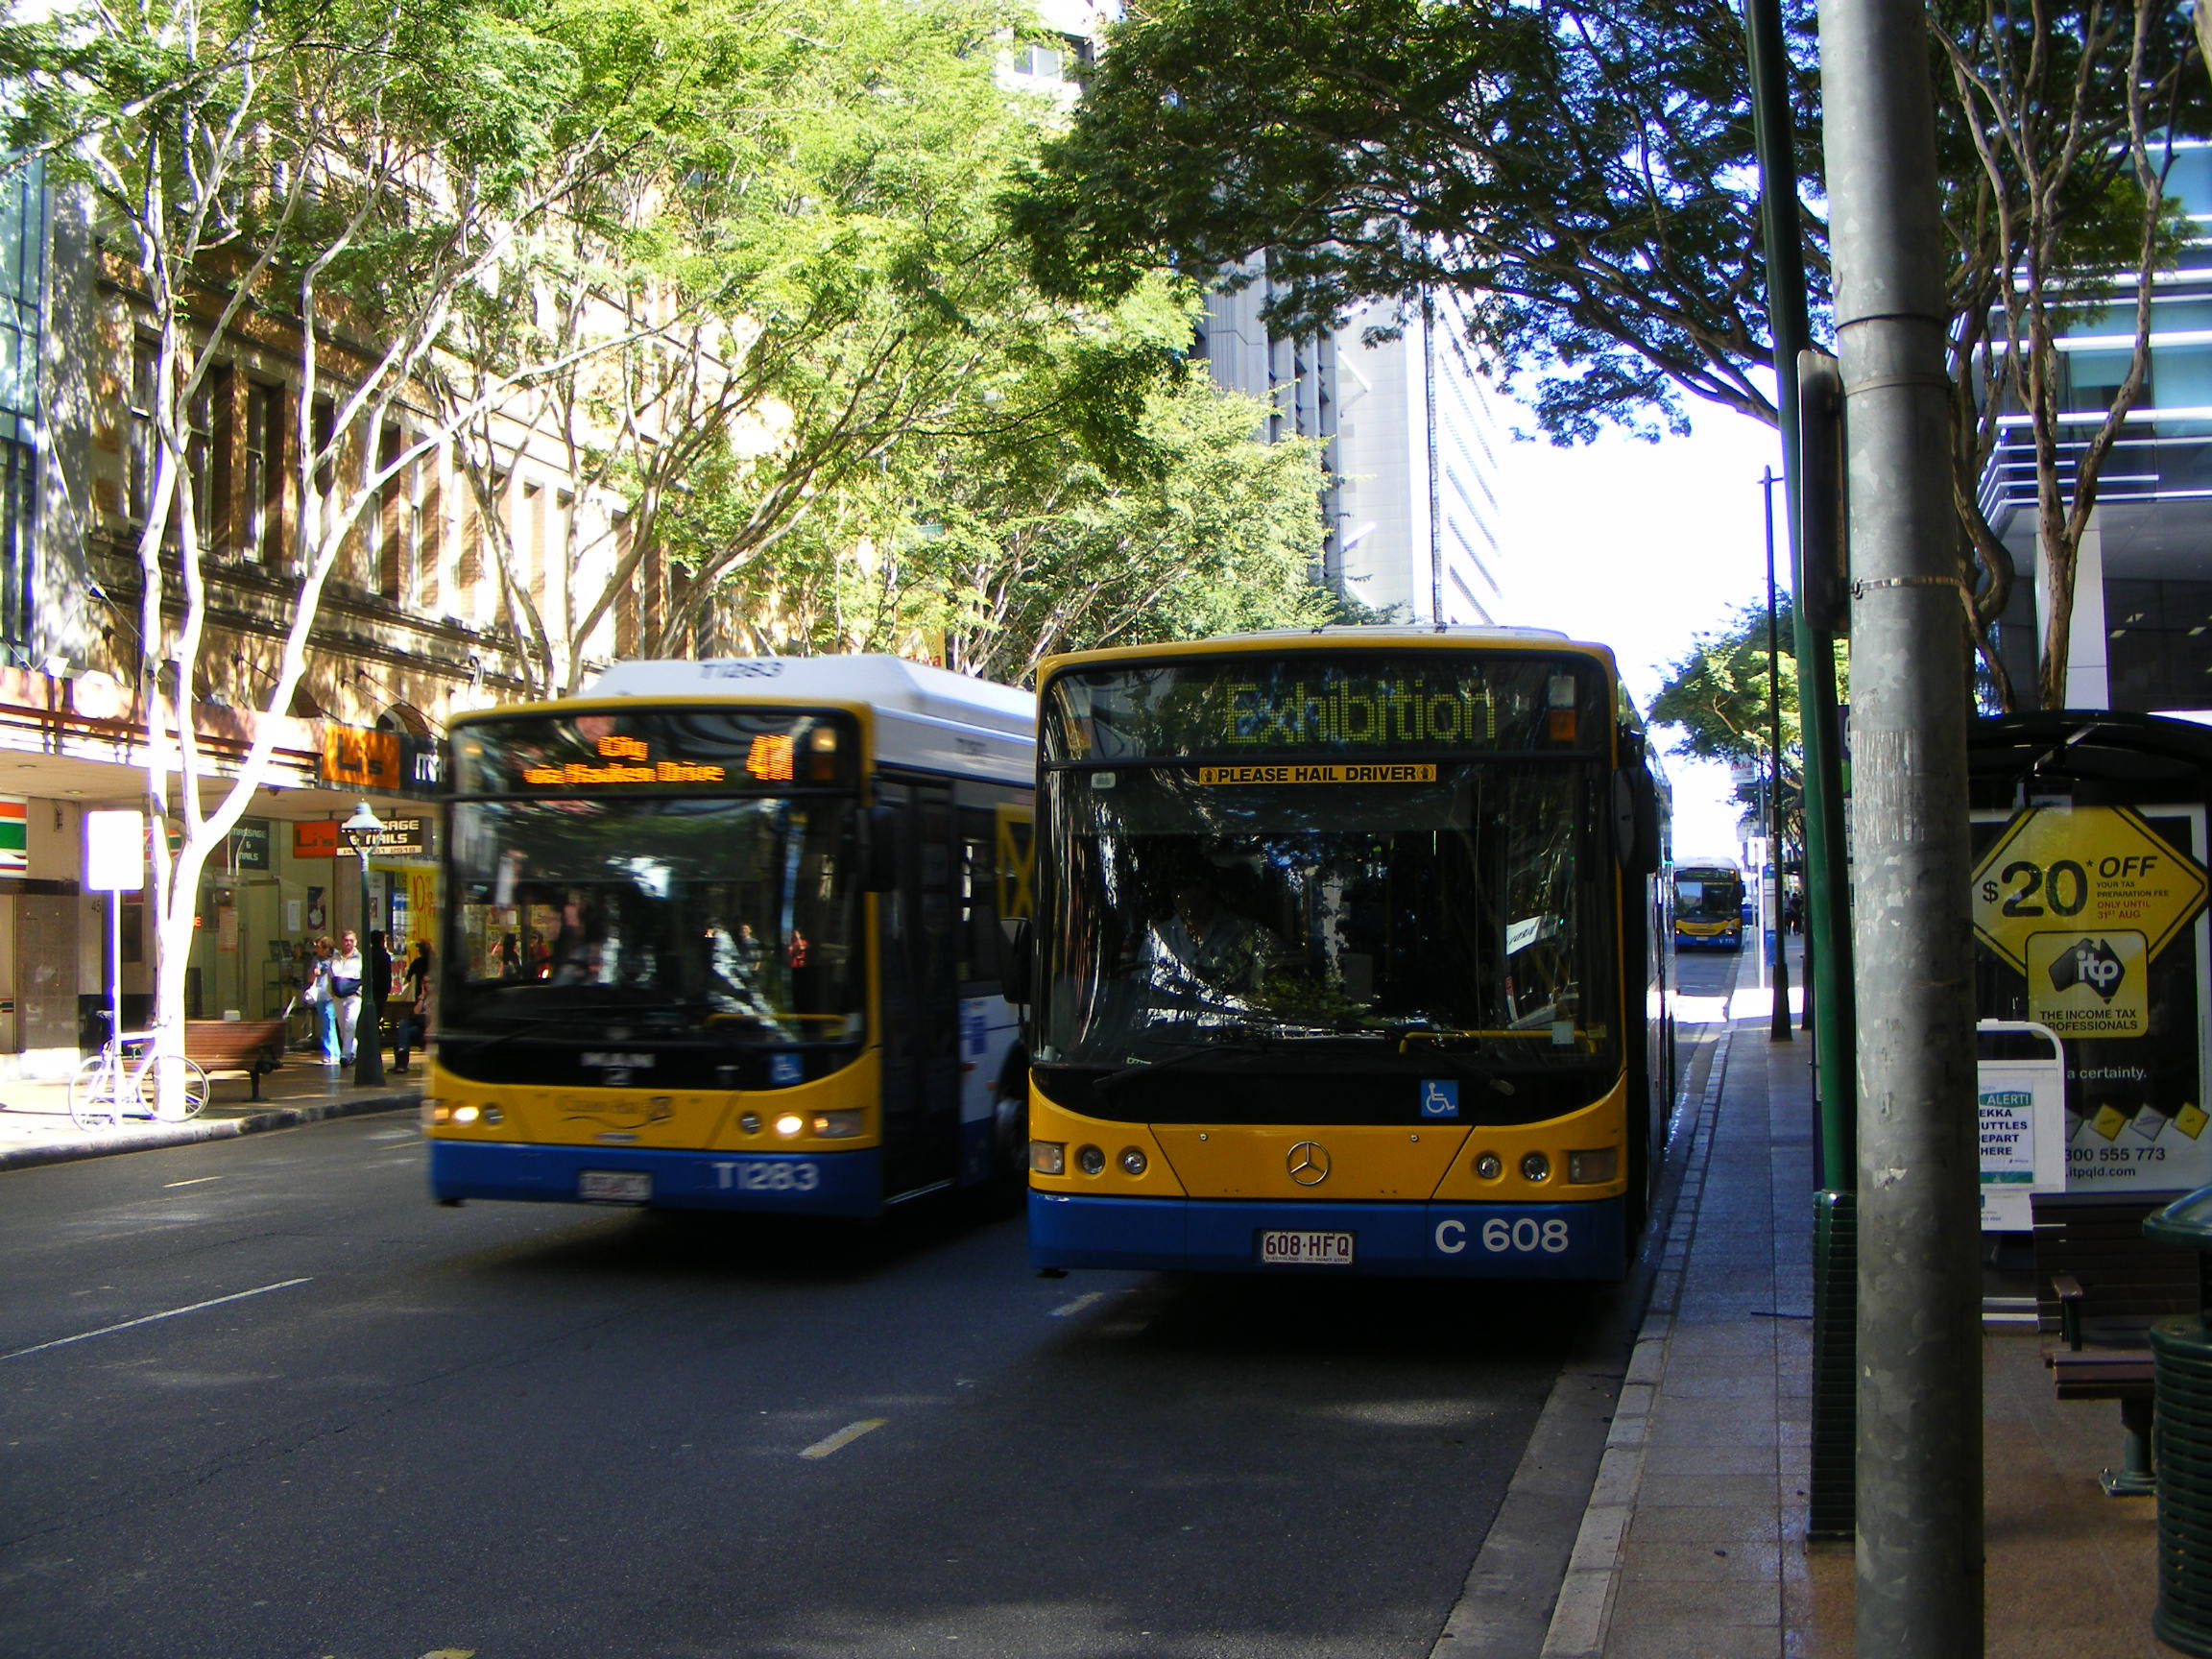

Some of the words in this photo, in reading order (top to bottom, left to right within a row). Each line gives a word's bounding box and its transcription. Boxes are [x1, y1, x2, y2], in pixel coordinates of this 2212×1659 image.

[1226, 680, 1495, 744] Exhibition
[1217, 768, 1287, 782] PLEASE
[1295, 767, 1338, 782] HAIL
[1345, 766, 1416, 781] DRIVER
[2099, 855, 2158, 878] OFF
[2098, 901, 2122, 909] ONLY
[2124, 901, 2152, 909] UNTIL
[2118, 910, 2141, 919] AUG
[2077, 950, 2119, 988] itp
[2040, 1011, 2063, 1021] THE
[2065, 1009, 2112, 1020] INCOME
[2115, 1008, 2136, 1019] TAX
[2067, 1070, 2076, 1079] a
[2080, 1067, 2147, 1081] certainty.
[1986, 1094, 2029, 1105] ALERT!
[1980, 1109, 2012, 1118] EKKA
[1981, 1146, 2012, 1156] HERE
[2099, 1148, 2129, 1162] 555
[2136, 1147, 2165, 1161] 773
[710, 1162, 819, 1190] T1283
[1435, 1219, 1467, 1253] C
[1482, 1217, 1569, 1253] 608
